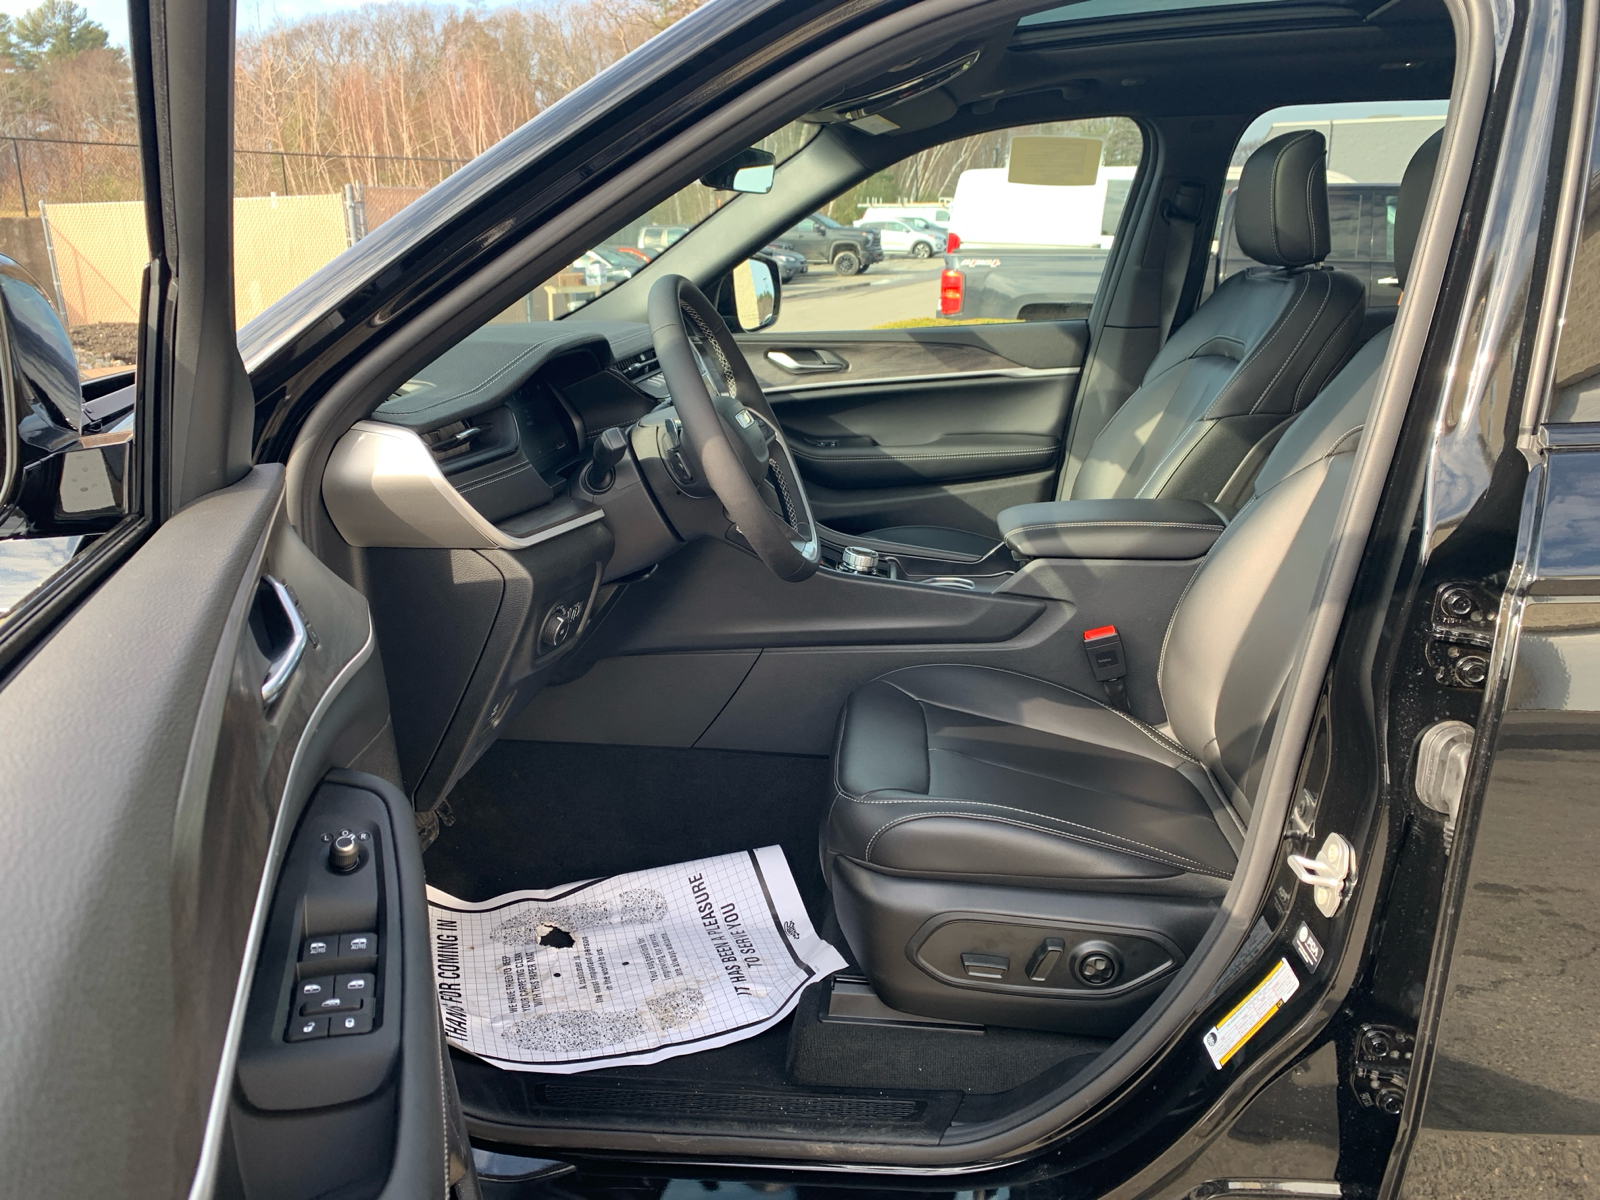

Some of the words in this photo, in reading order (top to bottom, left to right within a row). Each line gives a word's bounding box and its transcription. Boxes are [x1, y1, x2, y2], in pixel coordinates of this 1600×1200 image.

[688, 872, 723, 935] PLEASURE
[720, 902, 741, 929] YOU
[437, 919, 457, 931] IN
[582, 937, 593, 956] person
[649, 934, 659, 948] service
[661, 933, 673, 950] welcome
[730, 930, 756, 954] SERVE
[437, 934, 460, 979] COMING
[668, 950, 680, 967] always
[713, 942, 737, 963] BEEN
[585, 957, 598, 980] important
[599, 962, 608, 975] world
[744, 957, 763, 968] TO
[528, 964, 538, 980] PAPER
[575, 962, 586, 984] customer
[650, 970, 658, 982] Your
[725, 965, 747, 983] HAS
[505, 975, 514, 990] TRIED
[516, 969, 528, 996] CARPETING
[531, 981, 540, 992] THIS
[592, 981, 601, 993] most
[438, 983, 462, 1003] FOR
[506, 990, 516, 1003] HAVE
[735, 986, 752, 996] IT
[521, 997, 530, 1012] YOUR
[533, 993, 543, 1007] WITH
[508, 1004, 518, 1013] WE
